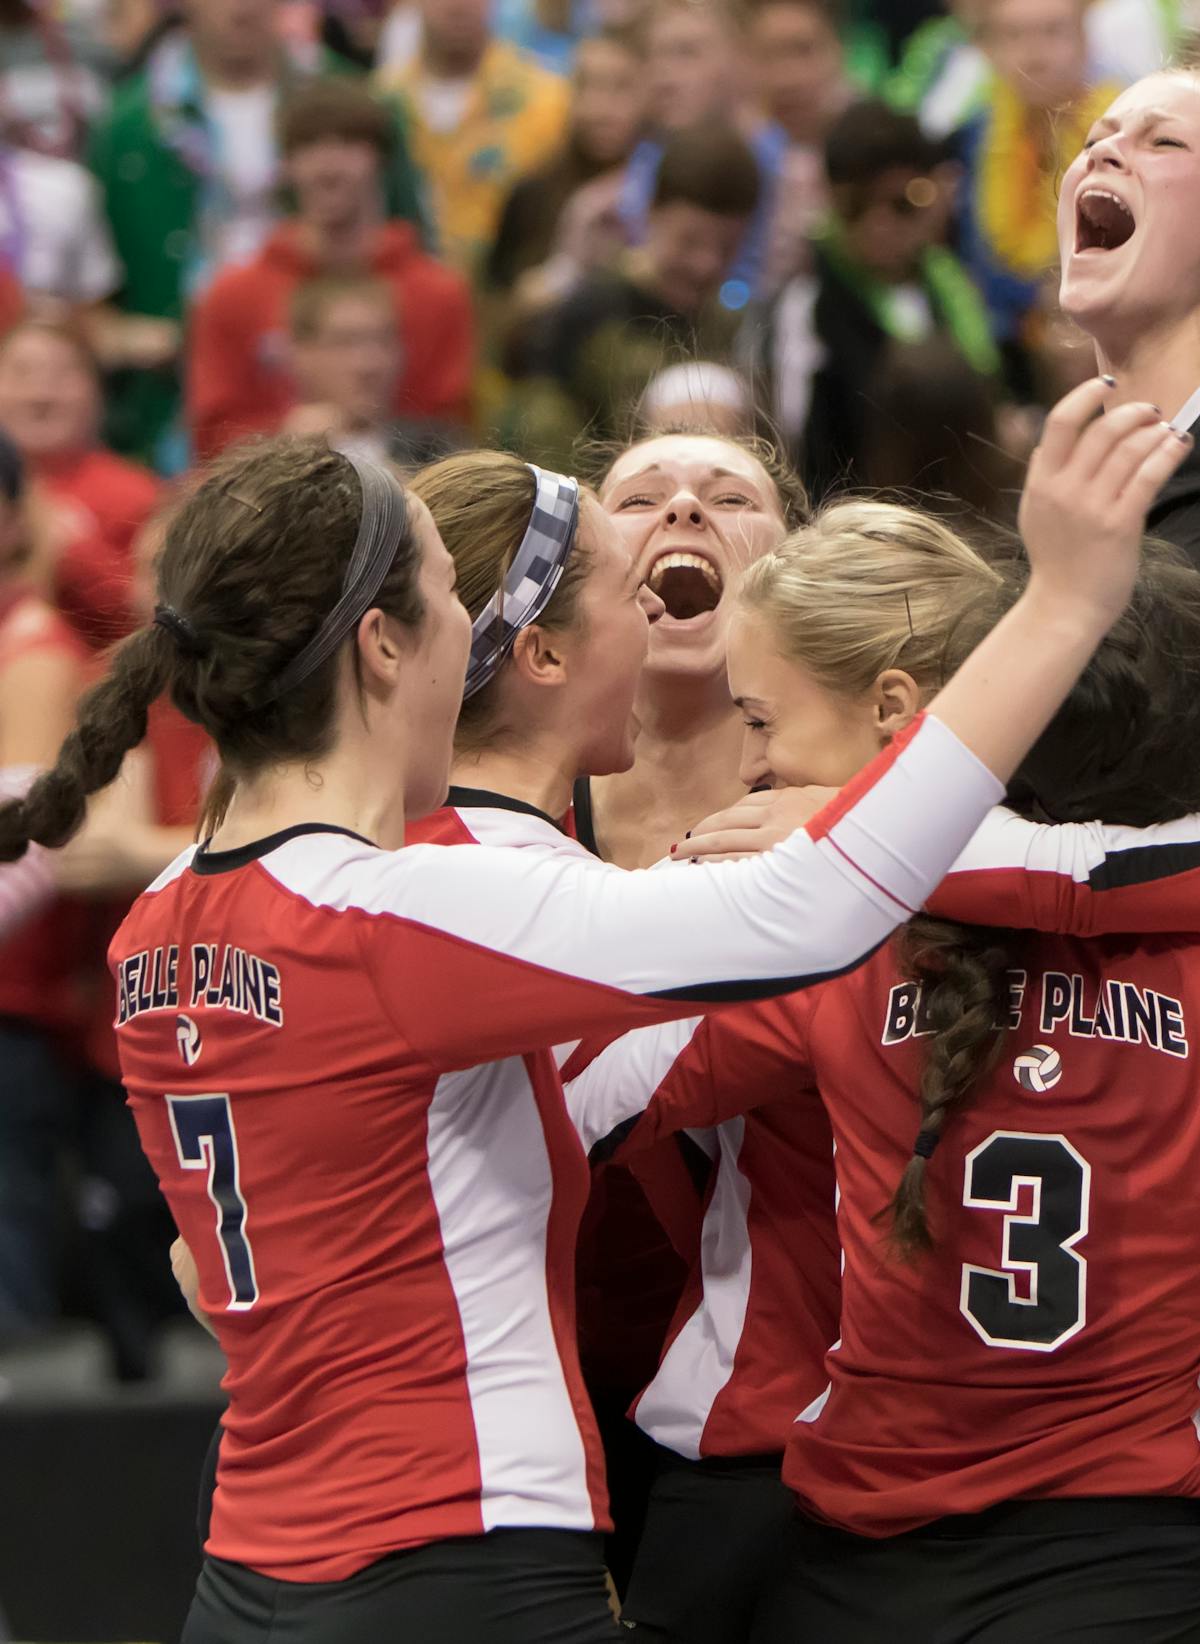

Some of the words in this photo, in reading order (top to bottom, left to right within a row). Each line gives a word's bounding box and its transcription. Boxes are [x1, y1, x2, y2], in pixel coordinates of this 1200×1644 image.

[189, 943, 283, 1027] PLAINE
[1040, 972, 1188, 1058] PLAINE
[165, 1093, 259, 1310] 7
[959, 1130, 1091, 1352] 3
